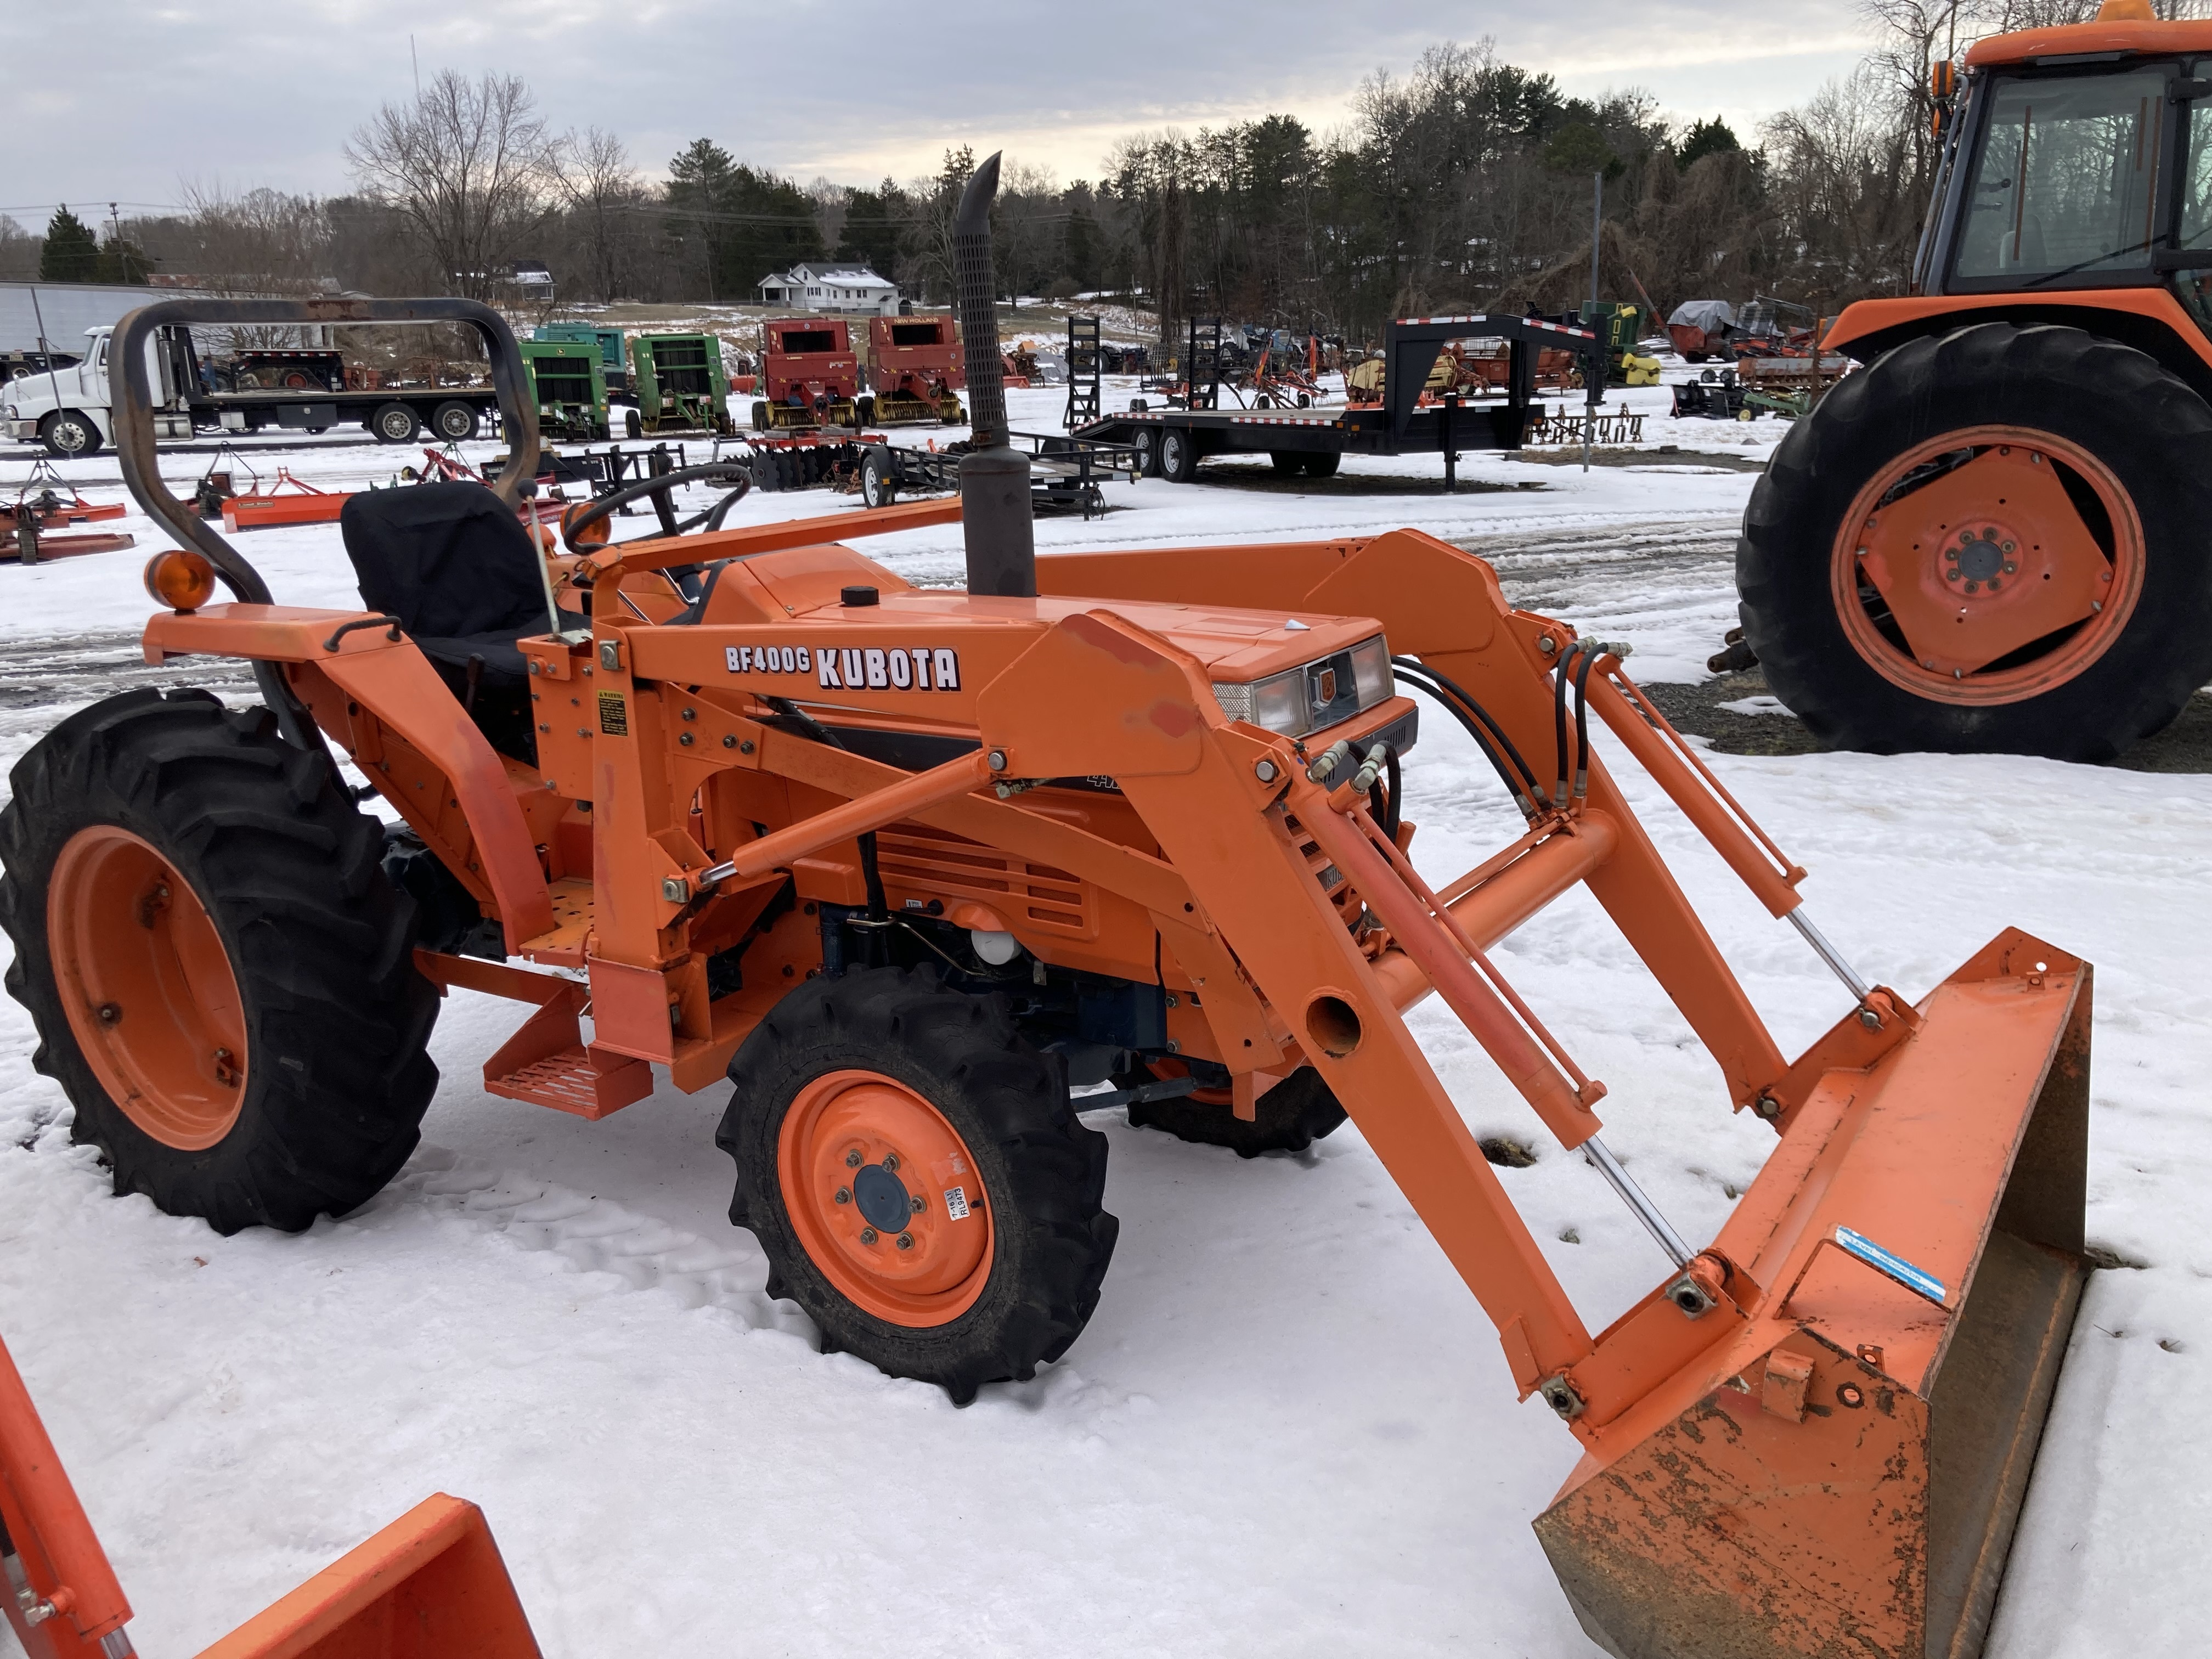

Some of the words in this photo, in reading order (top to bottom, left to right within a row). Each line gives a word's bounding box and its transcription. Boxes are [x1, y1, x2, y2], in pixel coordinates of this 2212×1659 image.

[725, 646, 812, 674] BF400G
[816, 648, 962, 691] KUBOTA
[955, 1188, 968, 1216] RL9473
[1880, 1255, 1921, 1280] INDICATOR
